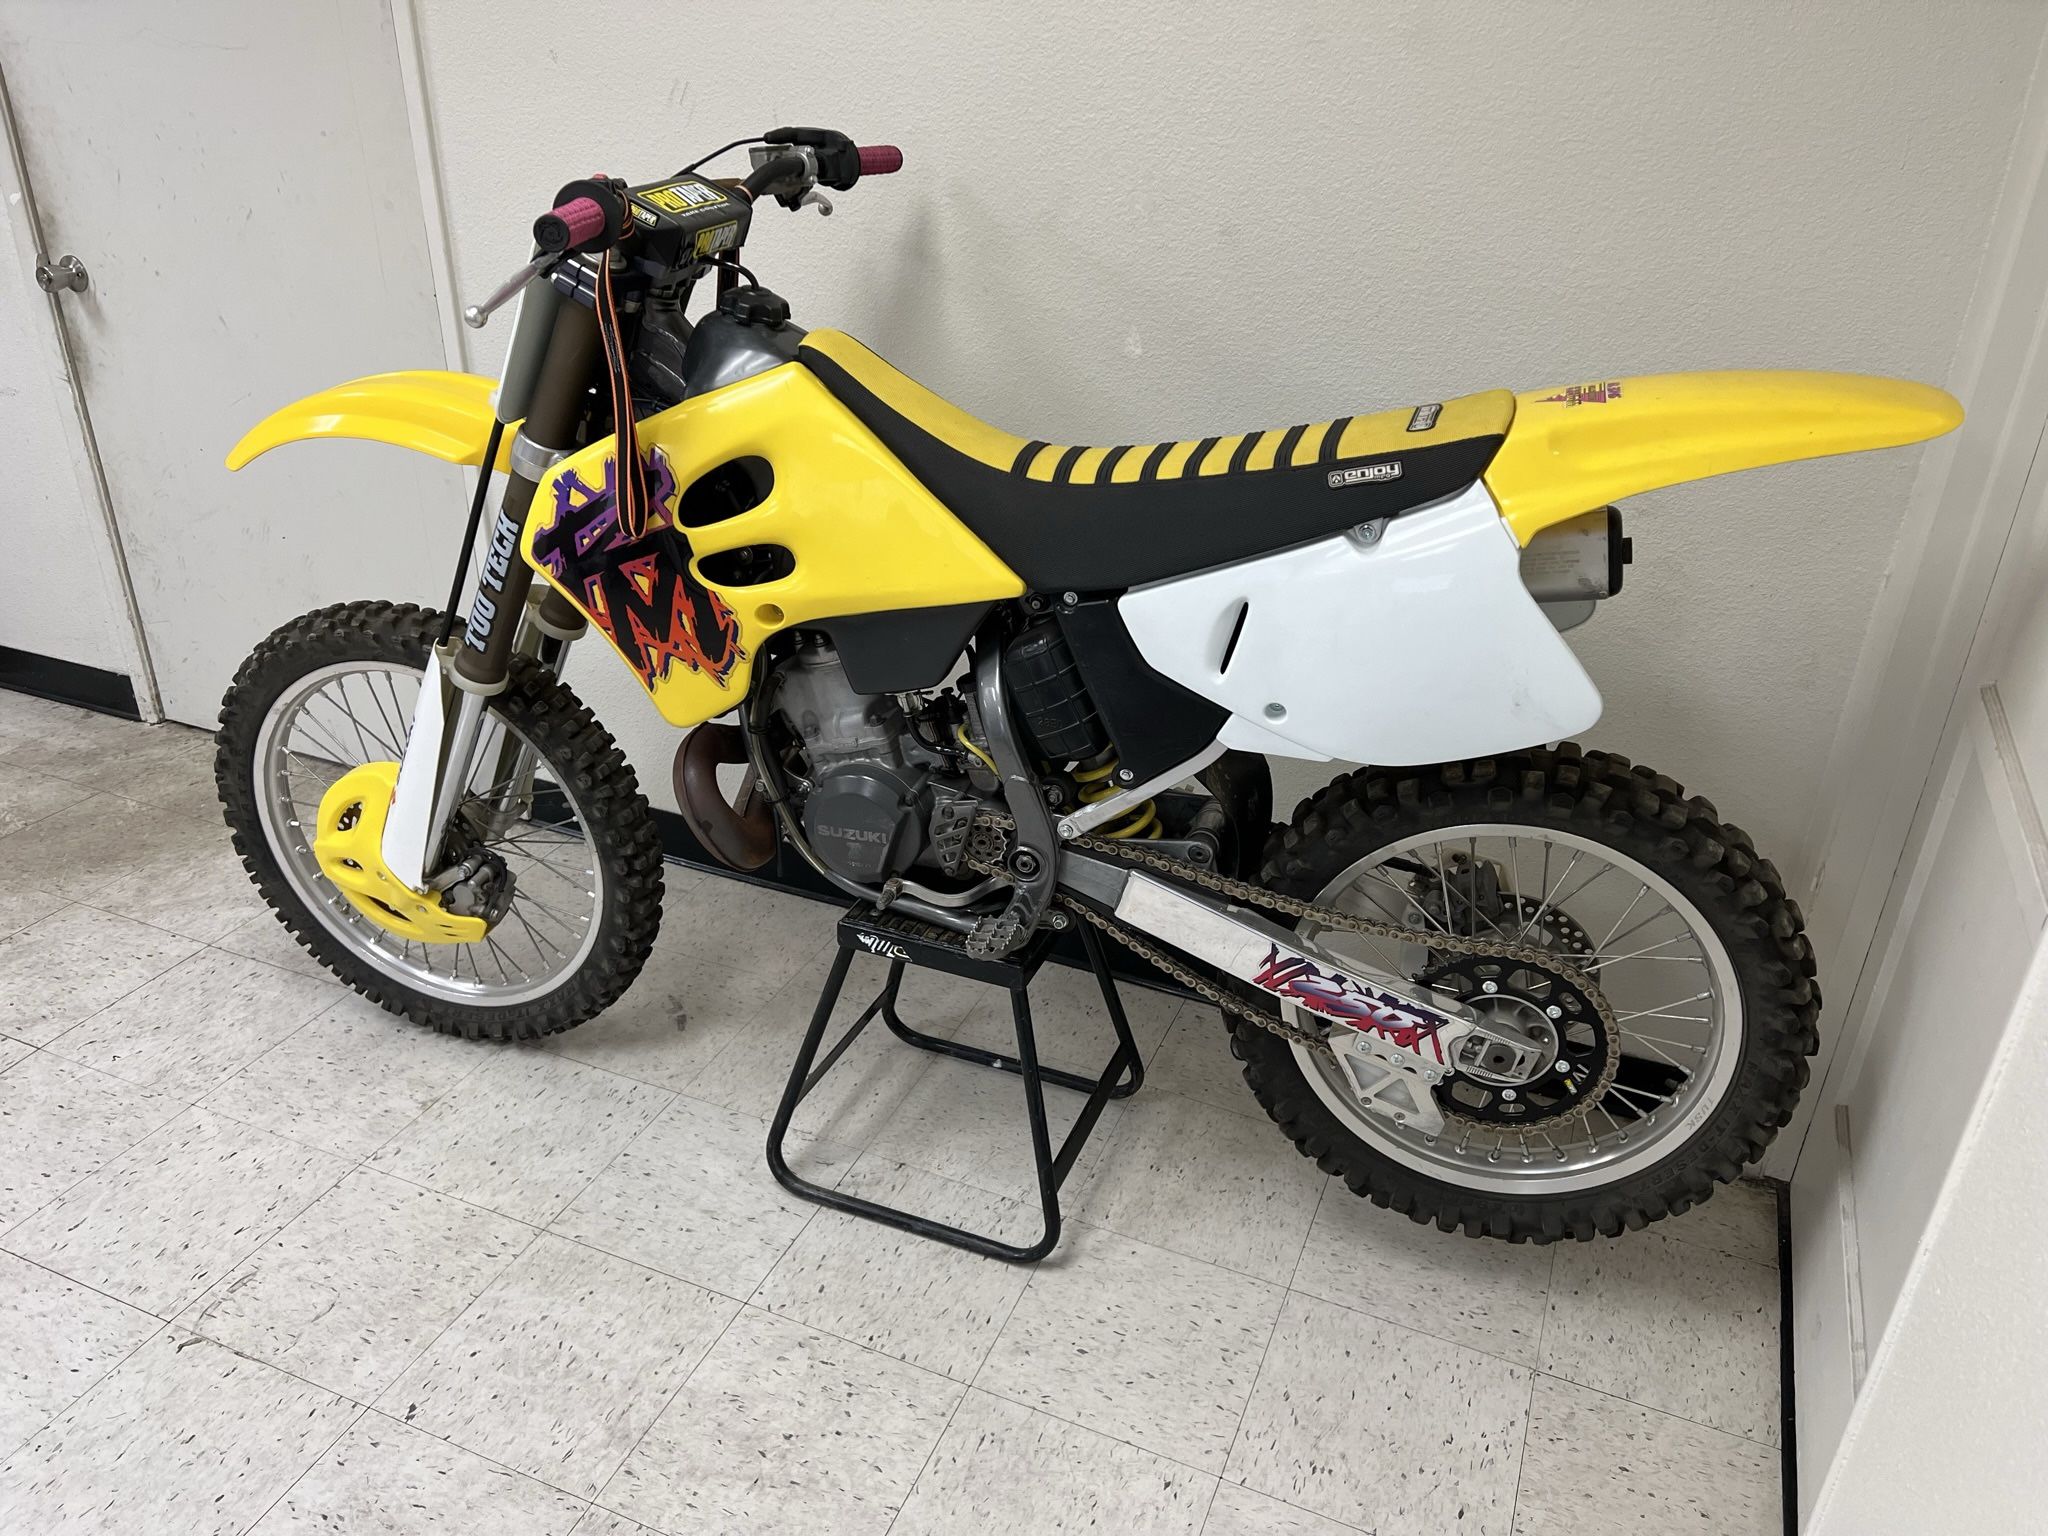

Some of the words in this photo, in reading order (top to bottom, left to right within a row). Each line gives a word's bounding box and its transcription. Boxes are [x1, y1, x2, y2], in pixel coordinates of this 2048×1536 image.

[645, 182, 721, 211] PROTAPER
[1344, 463, 1400, 482] enjoy
[465, 589, 497, 652] TOO
[481, 508, 519, 592] TECH
[816, 824, 888, 845] SUZUKI
[1685, 1097, 1715, 1131] TUSK
